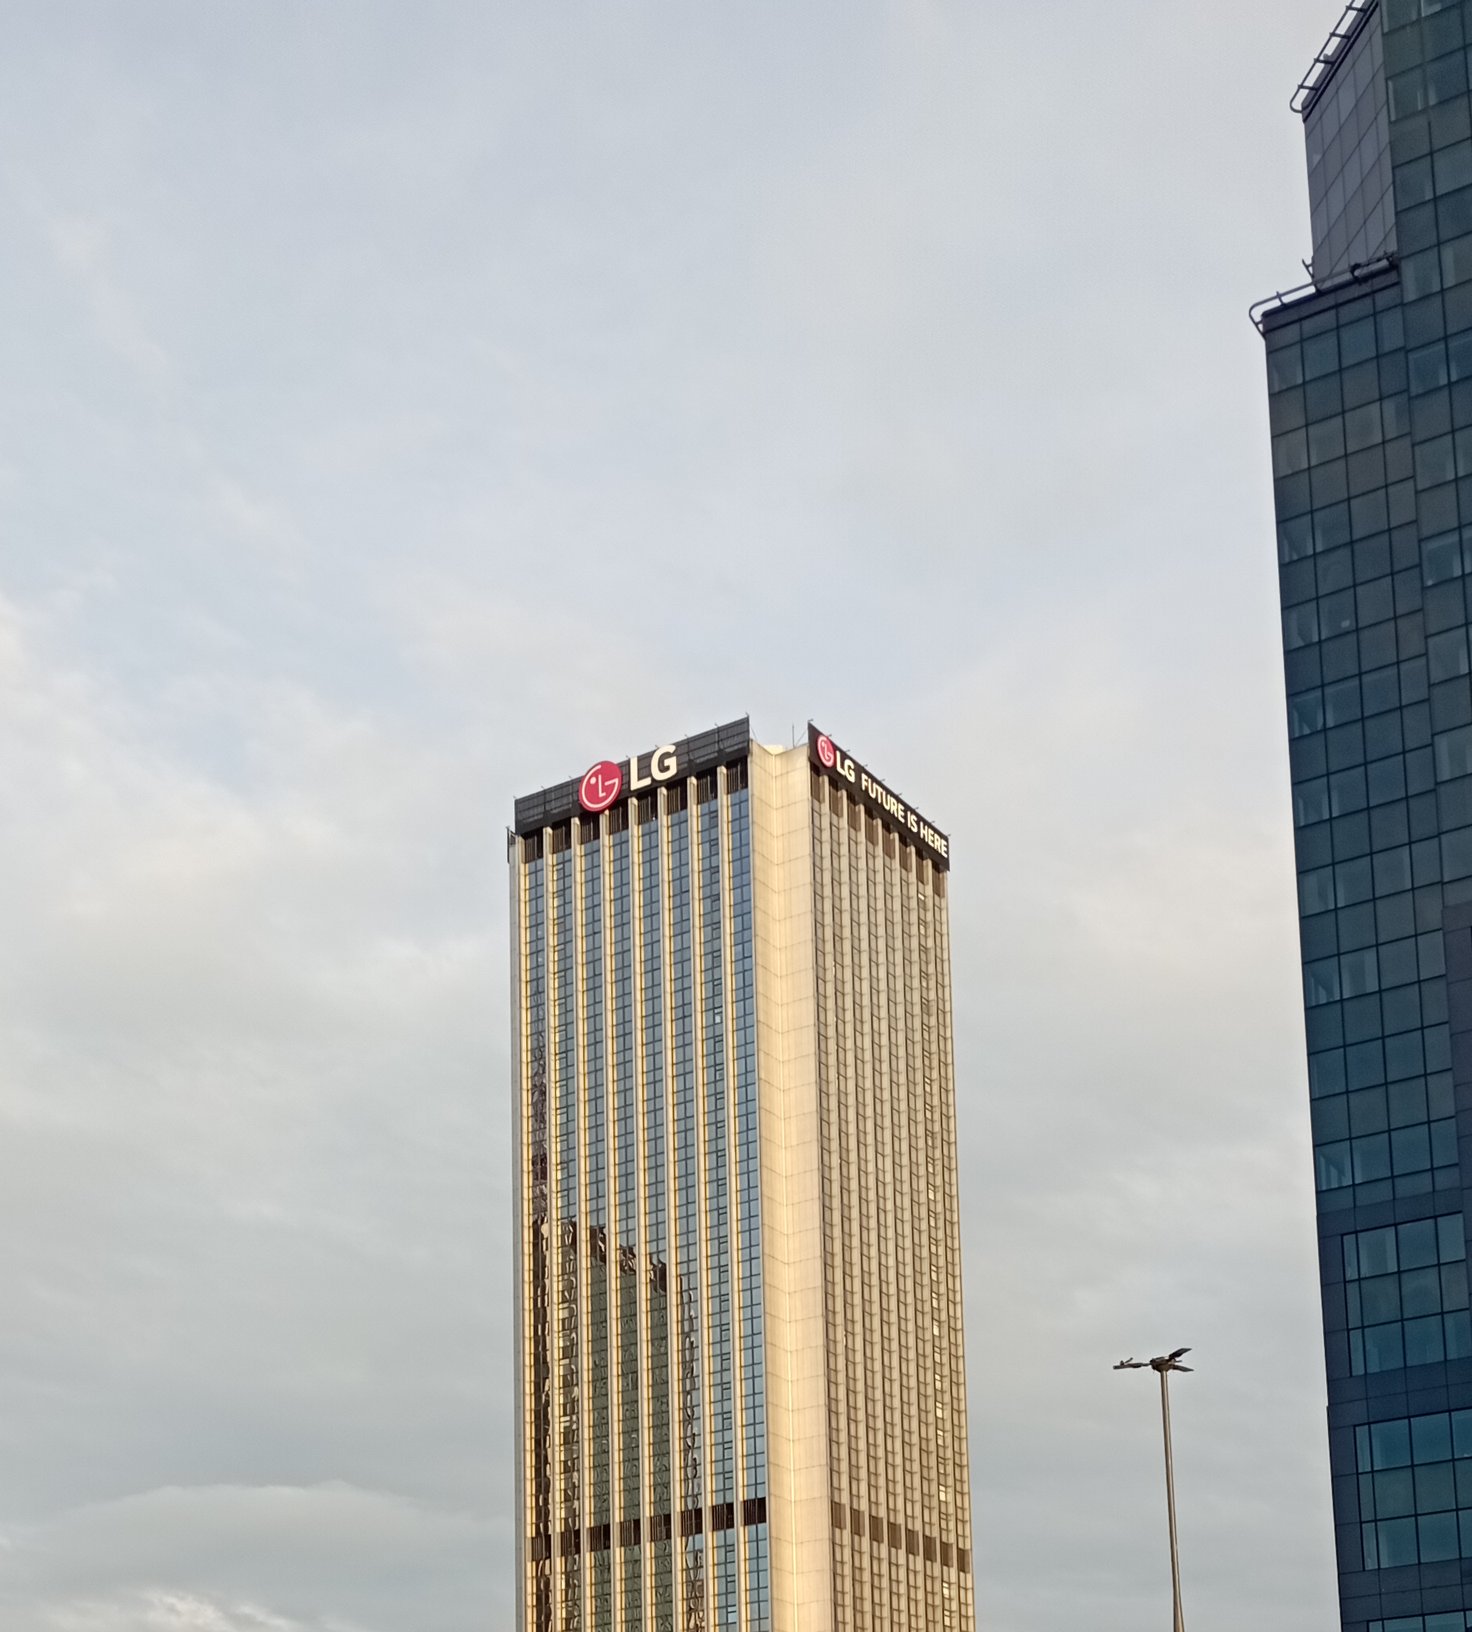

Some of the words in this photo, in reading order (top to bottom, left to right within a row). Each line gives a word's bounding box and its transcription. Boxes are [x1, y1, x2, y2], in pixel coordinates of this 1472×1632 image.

[630, 745, 677, 791] LG
[836, 750, 855, 783] LG
[861, 772, 905, 823] FUTURE
[907, 811, 918, 833] IS
[920, 821, 948, 858] HERE
